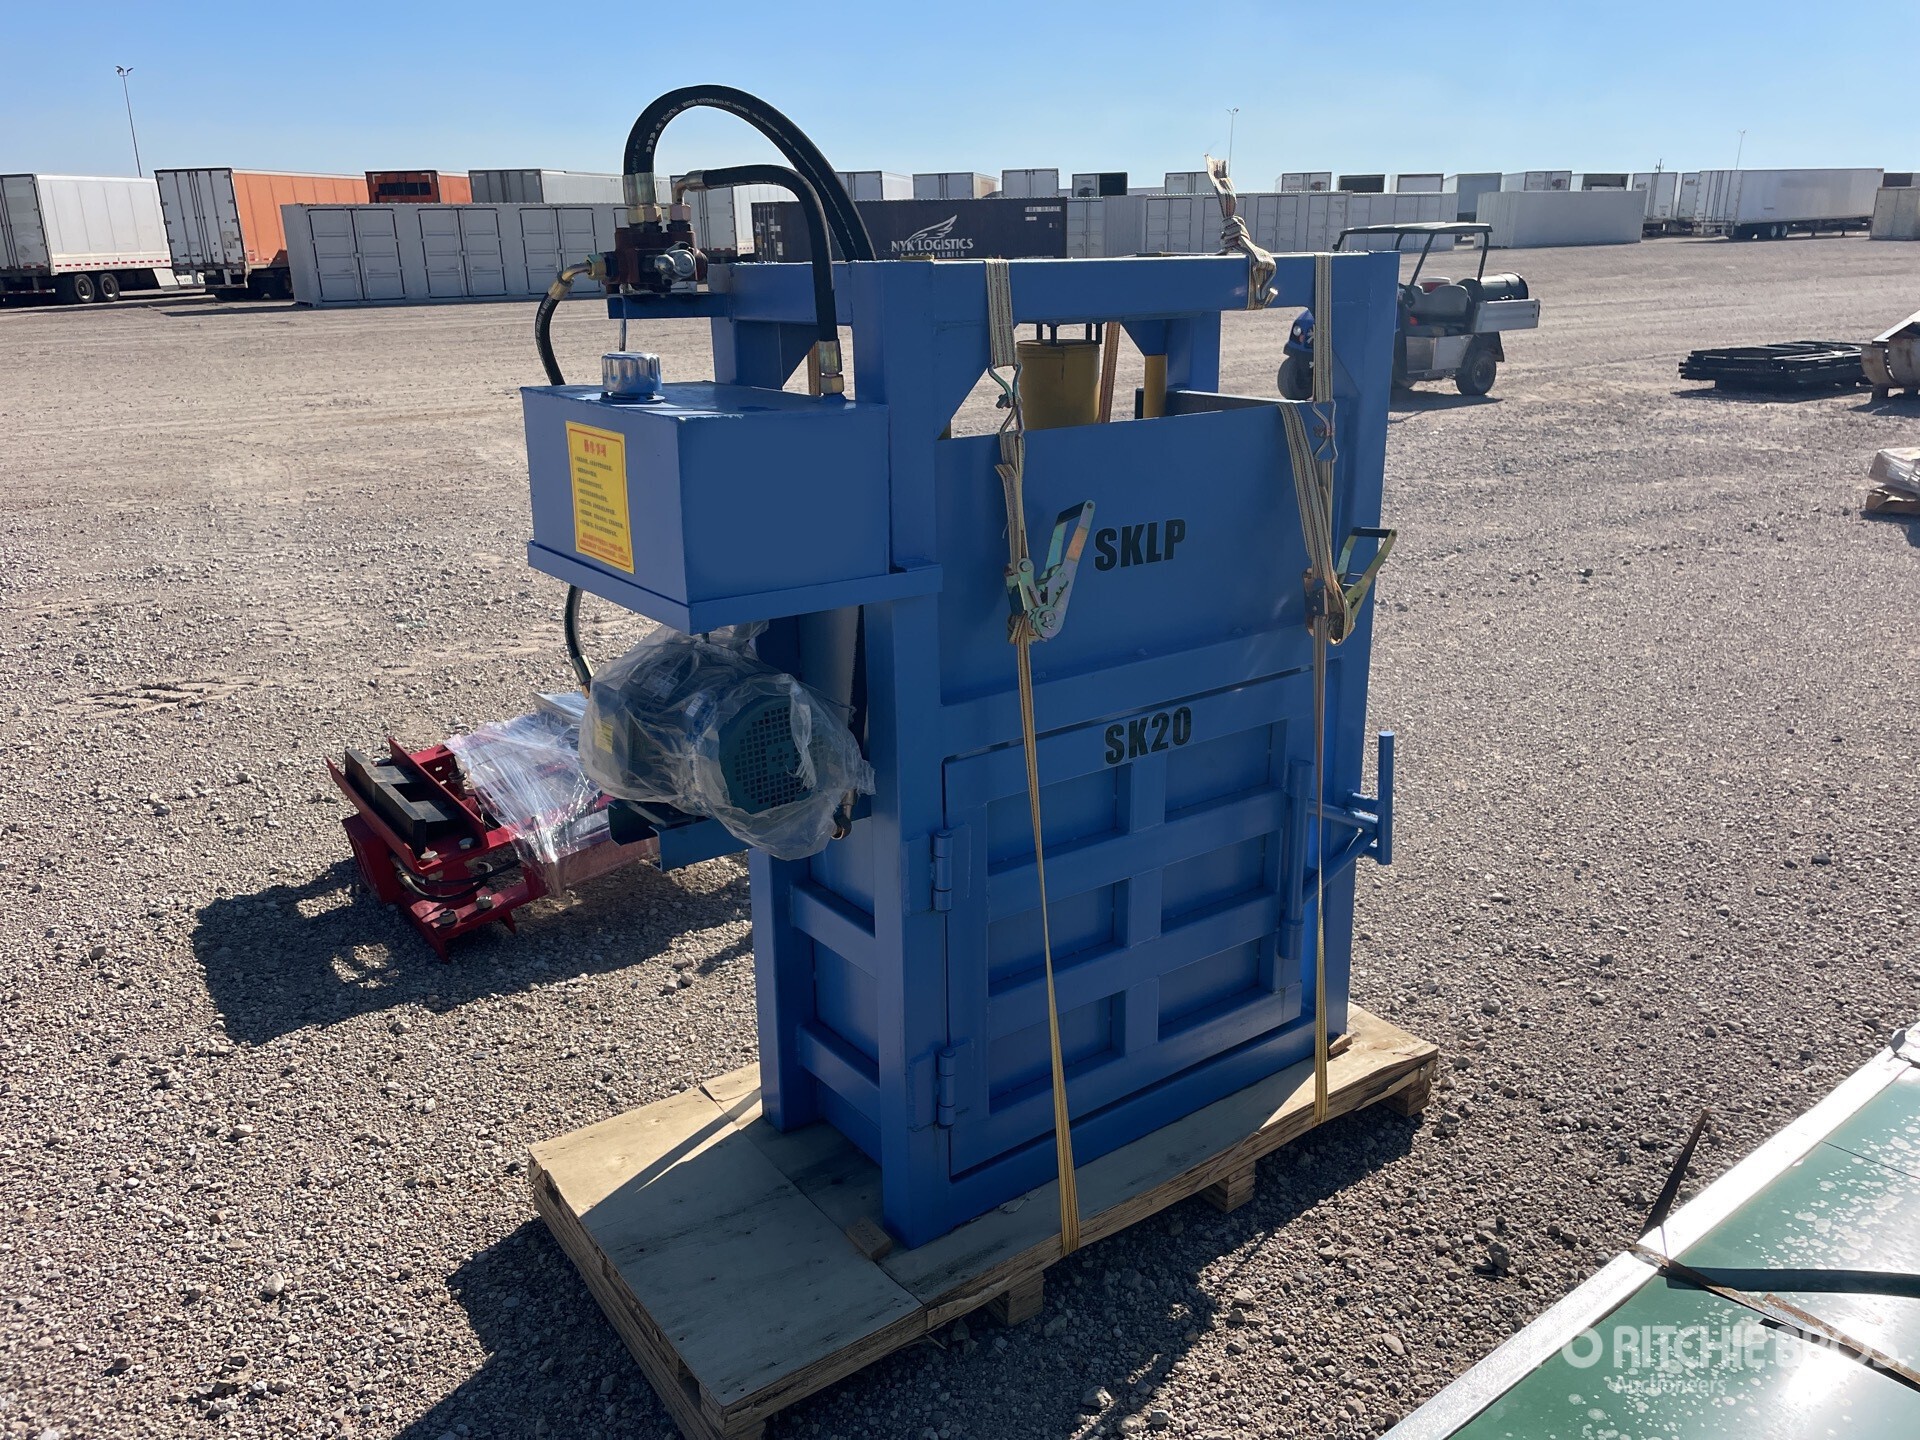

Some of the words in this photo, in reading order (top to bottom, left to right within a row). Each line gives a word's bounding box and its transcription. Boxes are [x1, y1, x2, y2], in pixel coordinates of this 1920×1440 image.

[891, 239, 915, 252] NYK
[918, 238, 974, 251] LOGISTICS
[1094, 518, 1186, 572] SKLP
[1105, 707, 1192, 765] SK20
